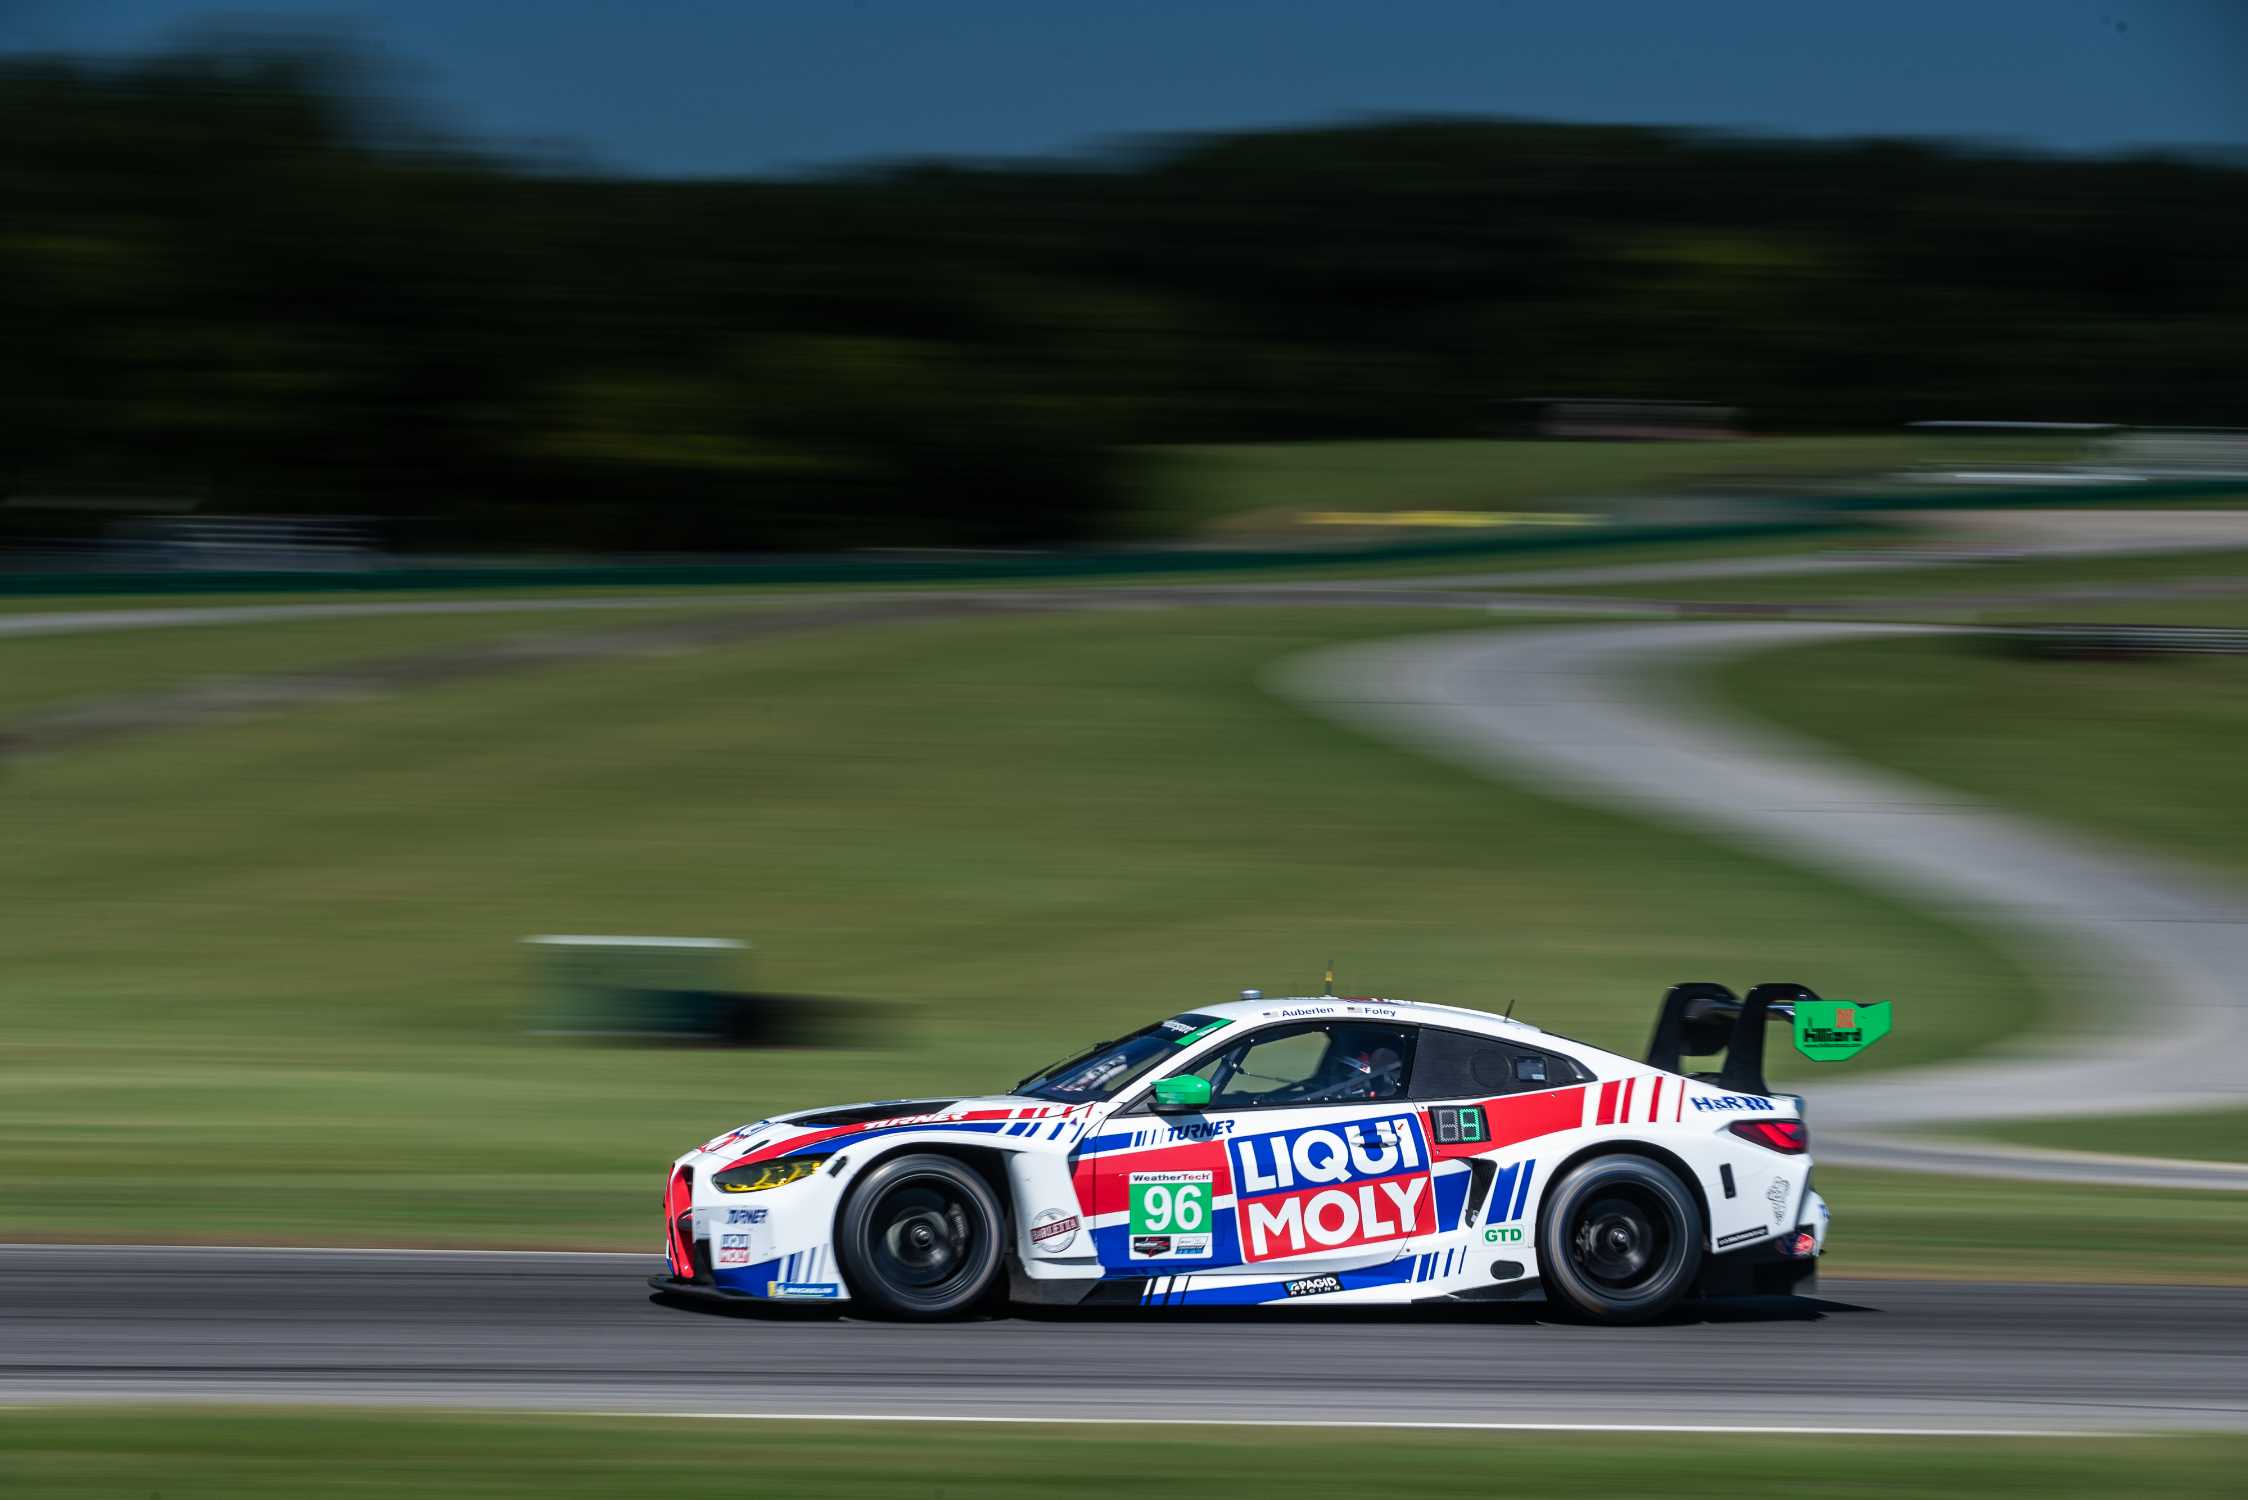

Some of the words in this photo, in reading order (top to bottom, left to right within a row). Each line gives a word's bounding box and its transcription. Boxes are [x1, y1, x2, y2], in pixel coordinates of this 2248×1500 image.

[1282, 1007, 1334, 1017] Auberlen
[1365, 1007, 1396, 1017] Foley
[1168, 1119, 1236, 1142] TURNER
[1237, 1118, 1419, 1193] LIQUI
[1132, 1173, 1210, 1182] WeatherTech
[1143, 1184, 1203, 1231] 96
[1247, 1176, 1428, 1257] MOLY
[1484, 1228, 1523, 1242] GTD
[1298, 1277, 1337, 1290] PAGID
